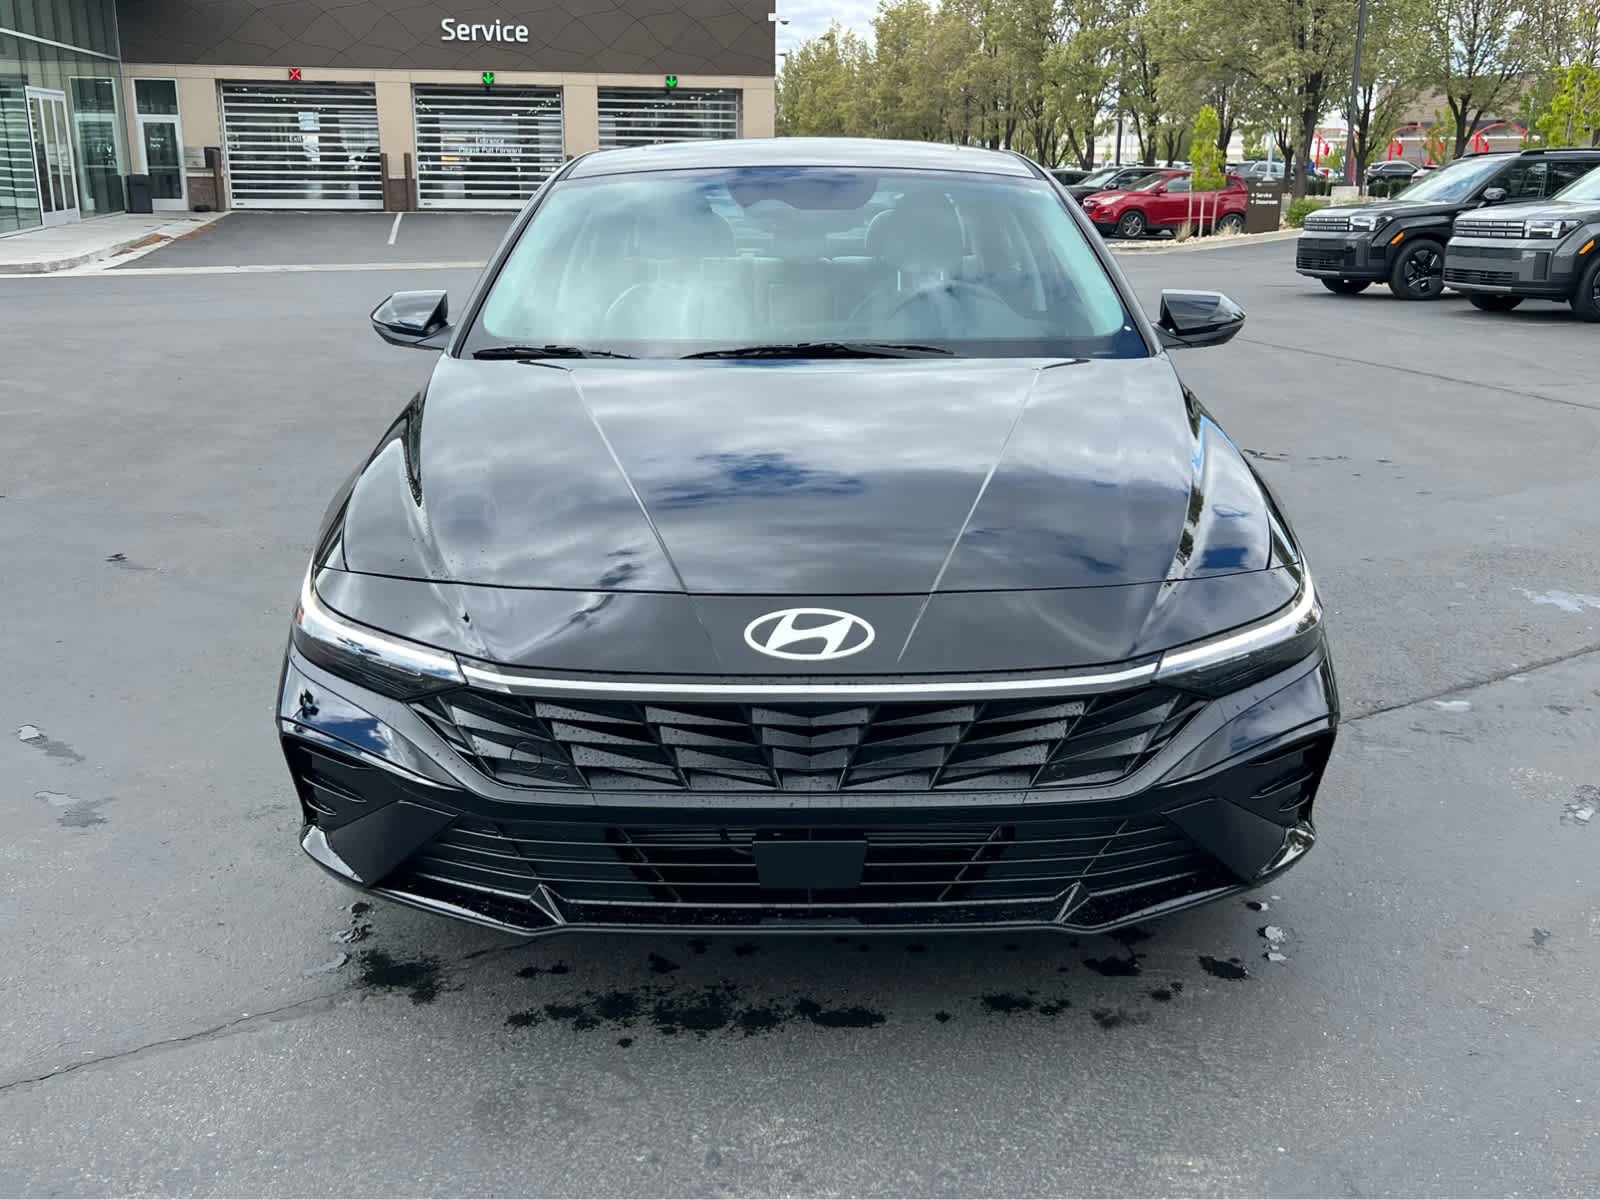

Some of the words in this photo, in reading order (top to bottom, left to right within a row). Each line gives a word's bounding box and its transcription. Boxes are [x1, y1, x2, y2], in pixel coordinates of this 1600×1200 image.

[441, 18, 529, 42] Service
[475, 136, 505, 145] Entrance
[481, 146, 494, 154] Pull
[495, 146, 523, 154] Forward
